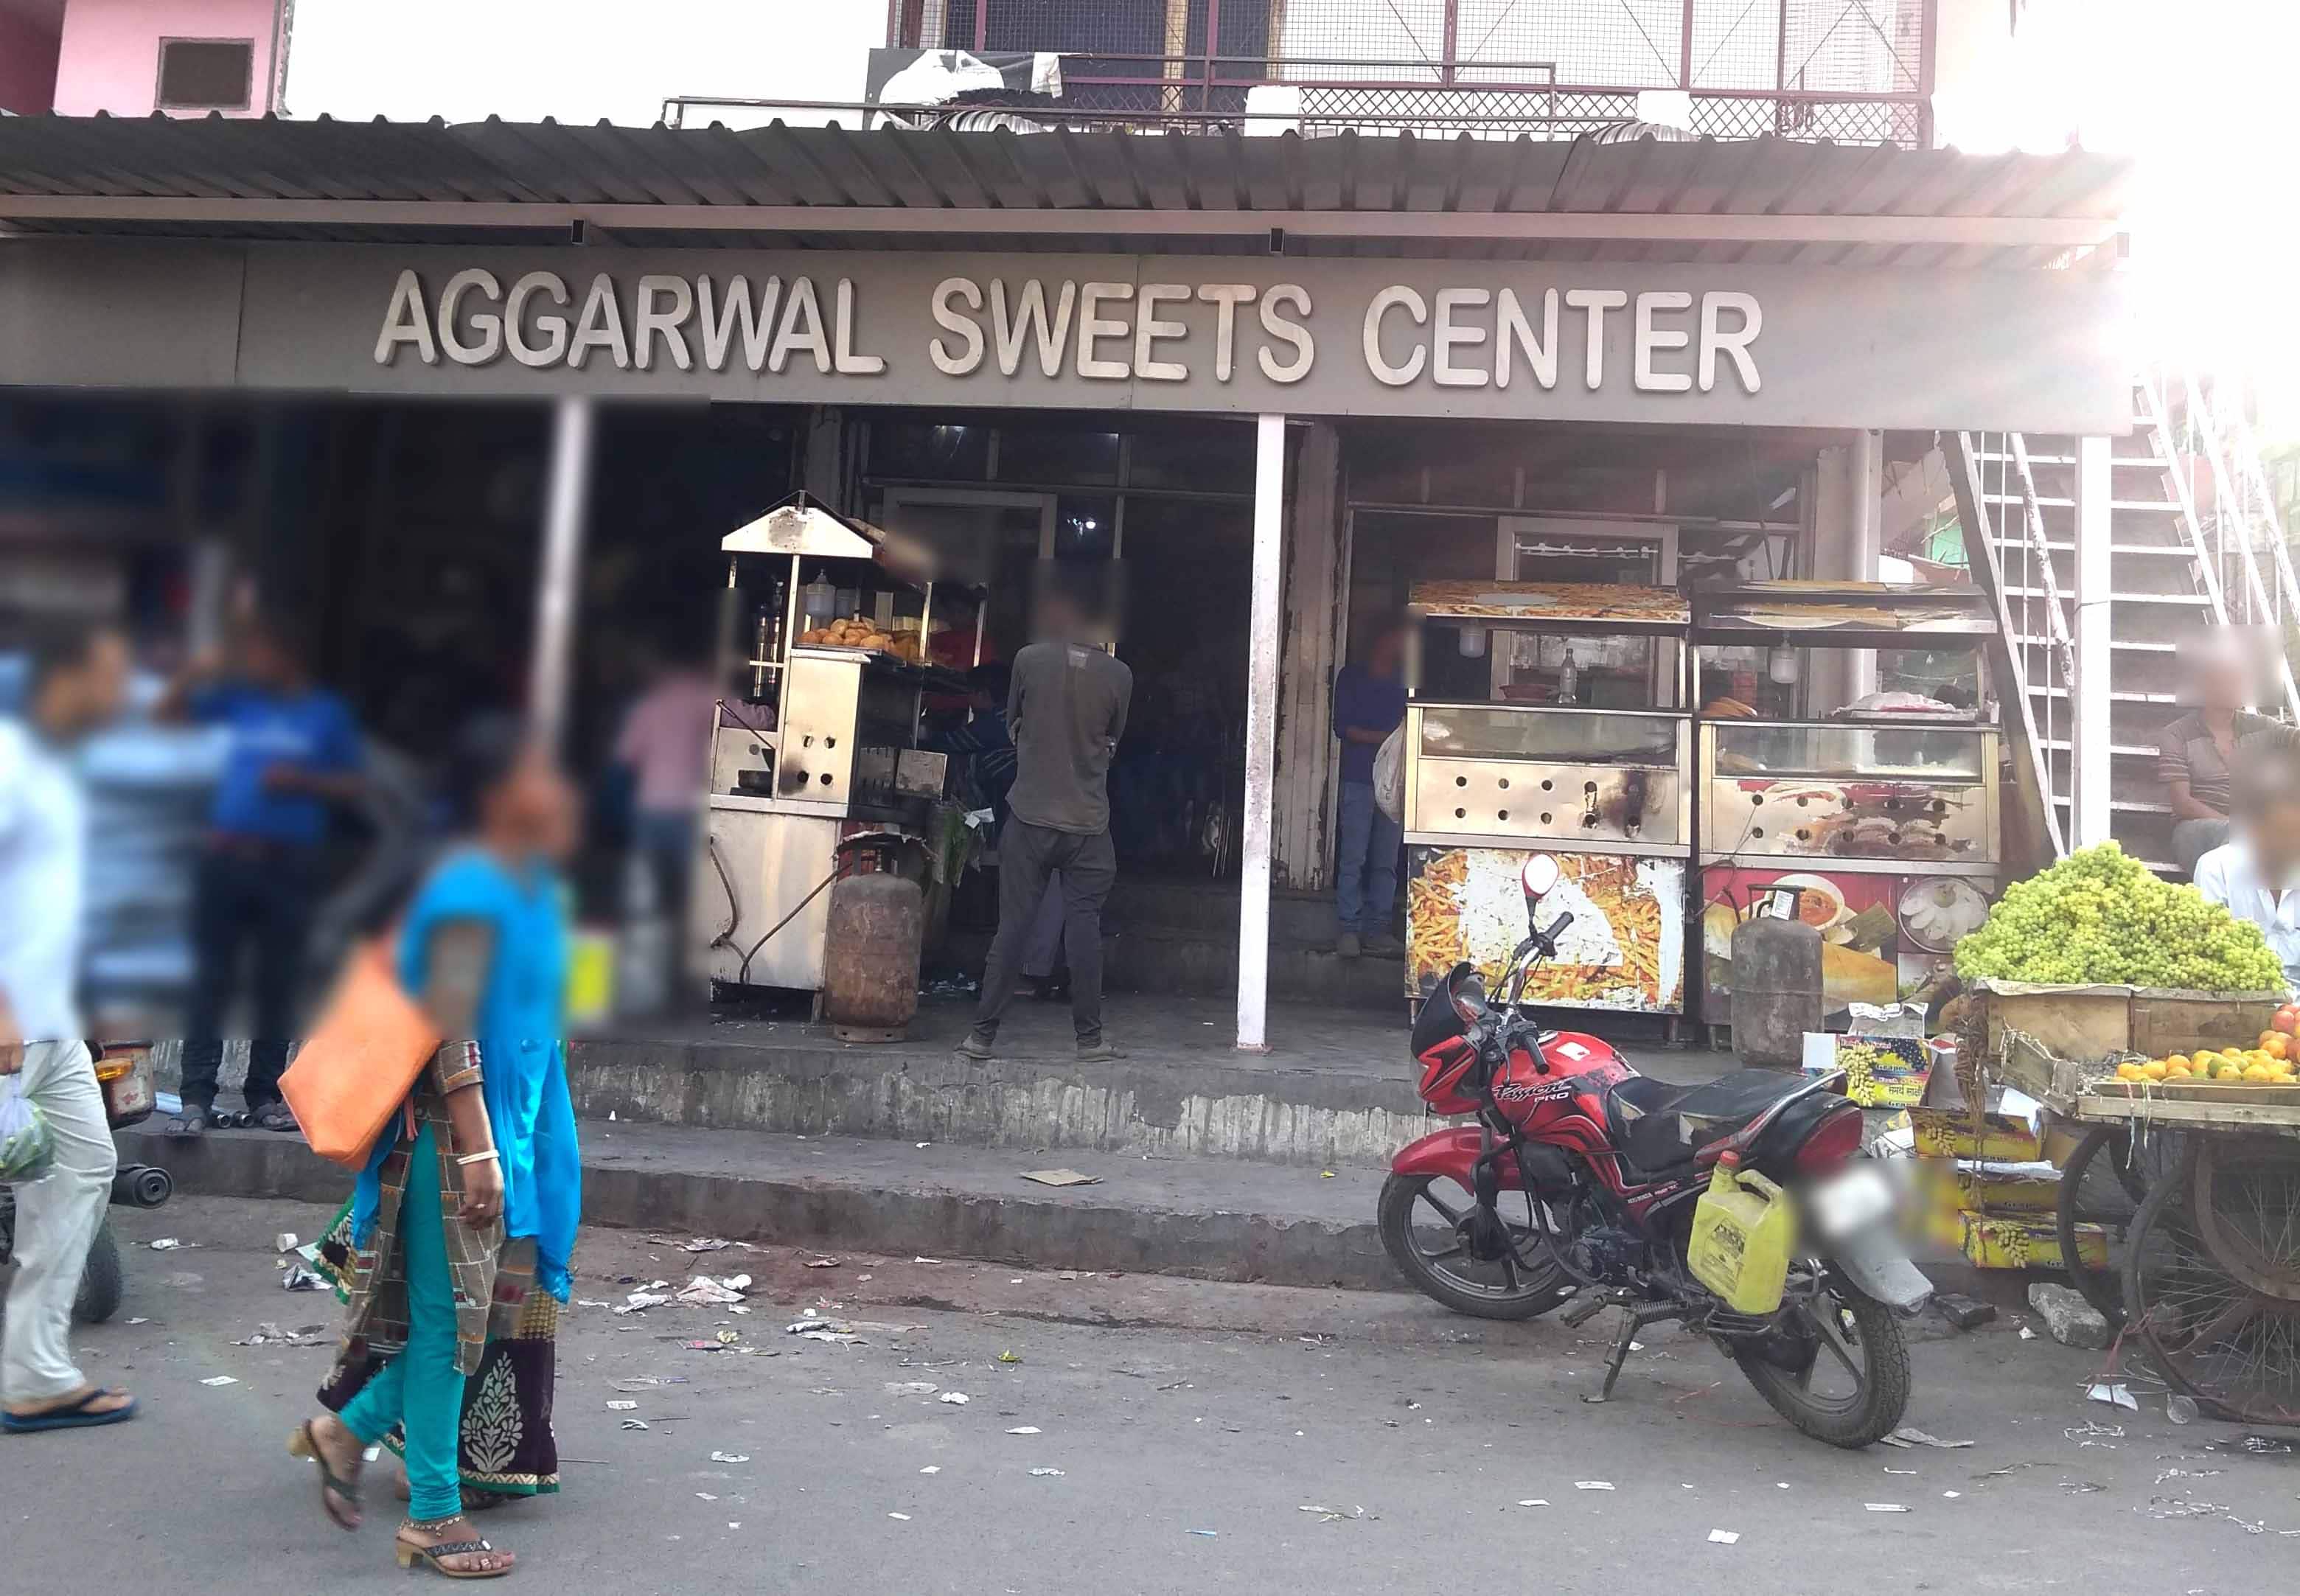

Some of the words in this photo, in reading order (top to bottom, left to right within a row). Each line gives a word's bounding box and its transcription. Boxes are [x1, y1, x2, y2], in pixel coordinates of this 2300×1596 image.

[374, 268, 886, 374] AGGARWAL
[930, 277, 1316, 385] SWEETS
[1362, 285, 1764, 396] CENTER
[1534, 1092, 1569, 1103] PRO
